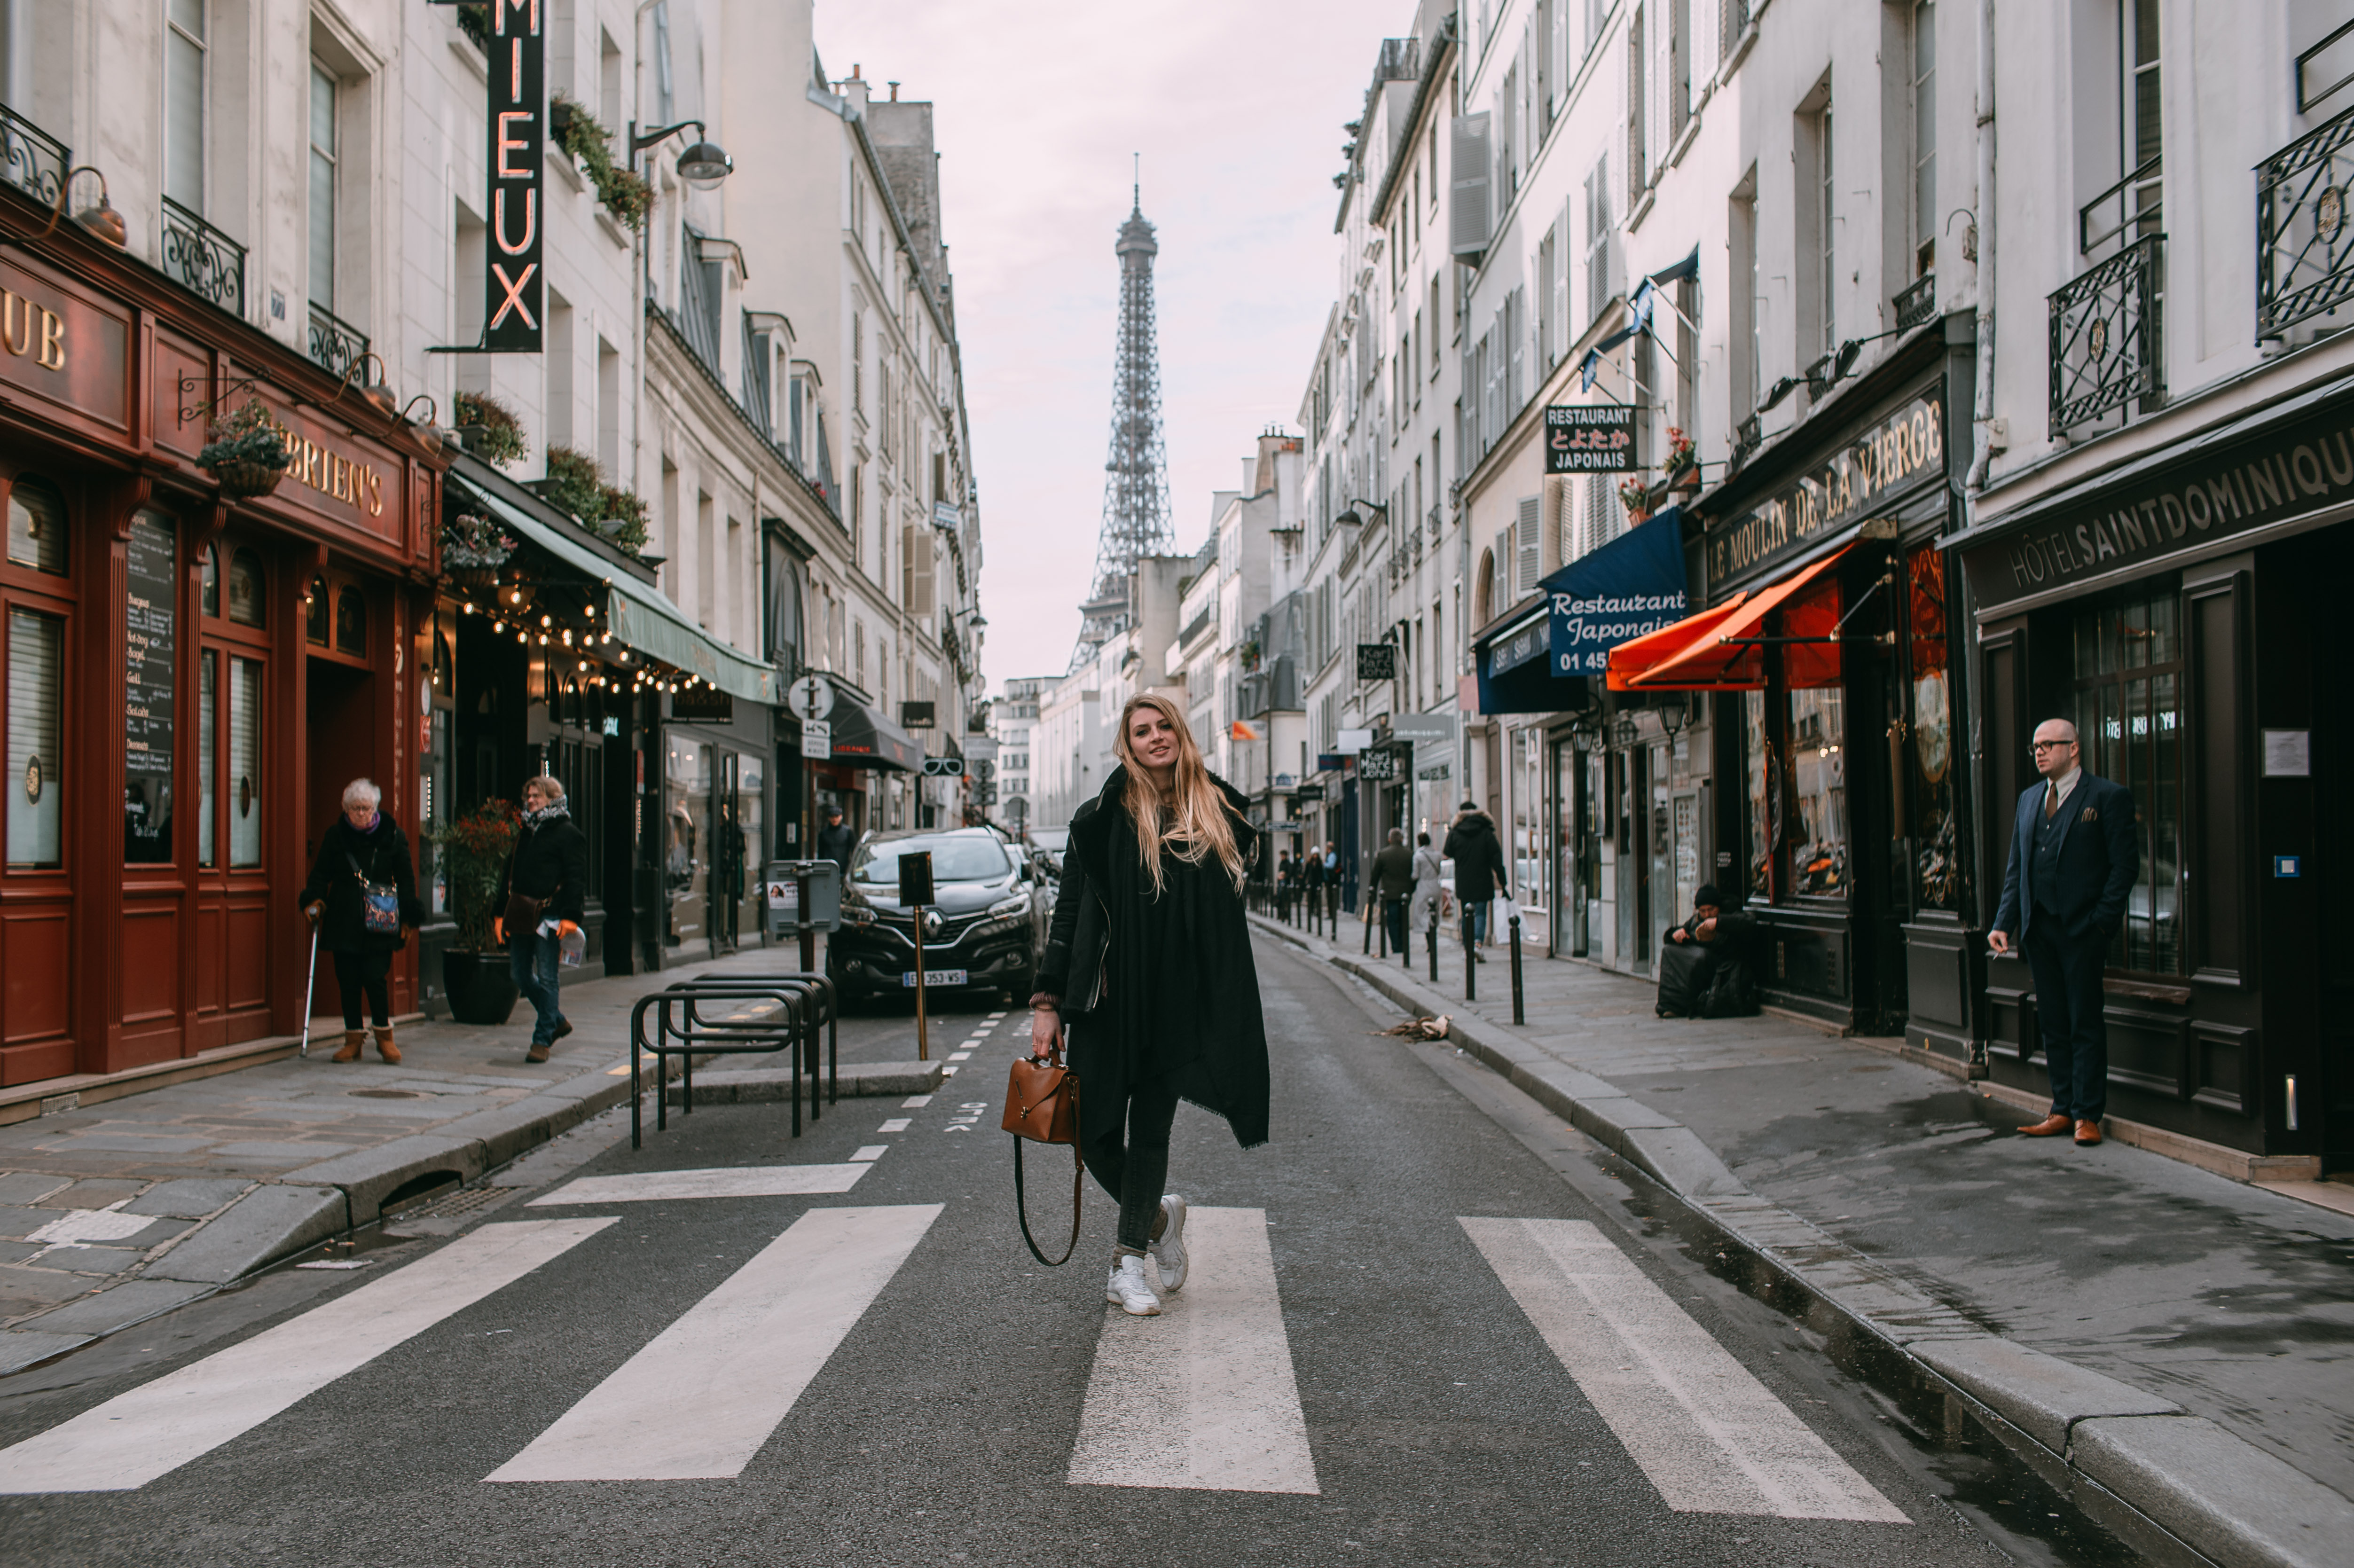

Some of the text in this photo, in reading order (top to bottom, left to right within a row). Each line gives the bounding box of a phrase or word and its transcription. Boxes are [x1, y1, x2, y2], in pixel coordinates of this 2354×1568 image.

[489, 0, 539, 330] MIEUX
[1548, 408, 1632, 425] RESTAURANT
[1551, 428, 1630, 450] とよたか
[1556, 452, 1625, 469] JAPONAIS
[1709, 400, 1942, 584] LE MOULIN DE LA VIERGE
[1552, 590, 1686, 616] Restaurant
[1358, 656, 1392, 667] Marc
[1364, 647, 1391, 659] Karl
[1560, 652, 1607, 670] 01 45
[1359, 664, 1392, 677] John
[1361, 759, 1390, 769] Marc
[1366, 750, 1390, 761] Karl
[1361, 768, 1391, 778] John
